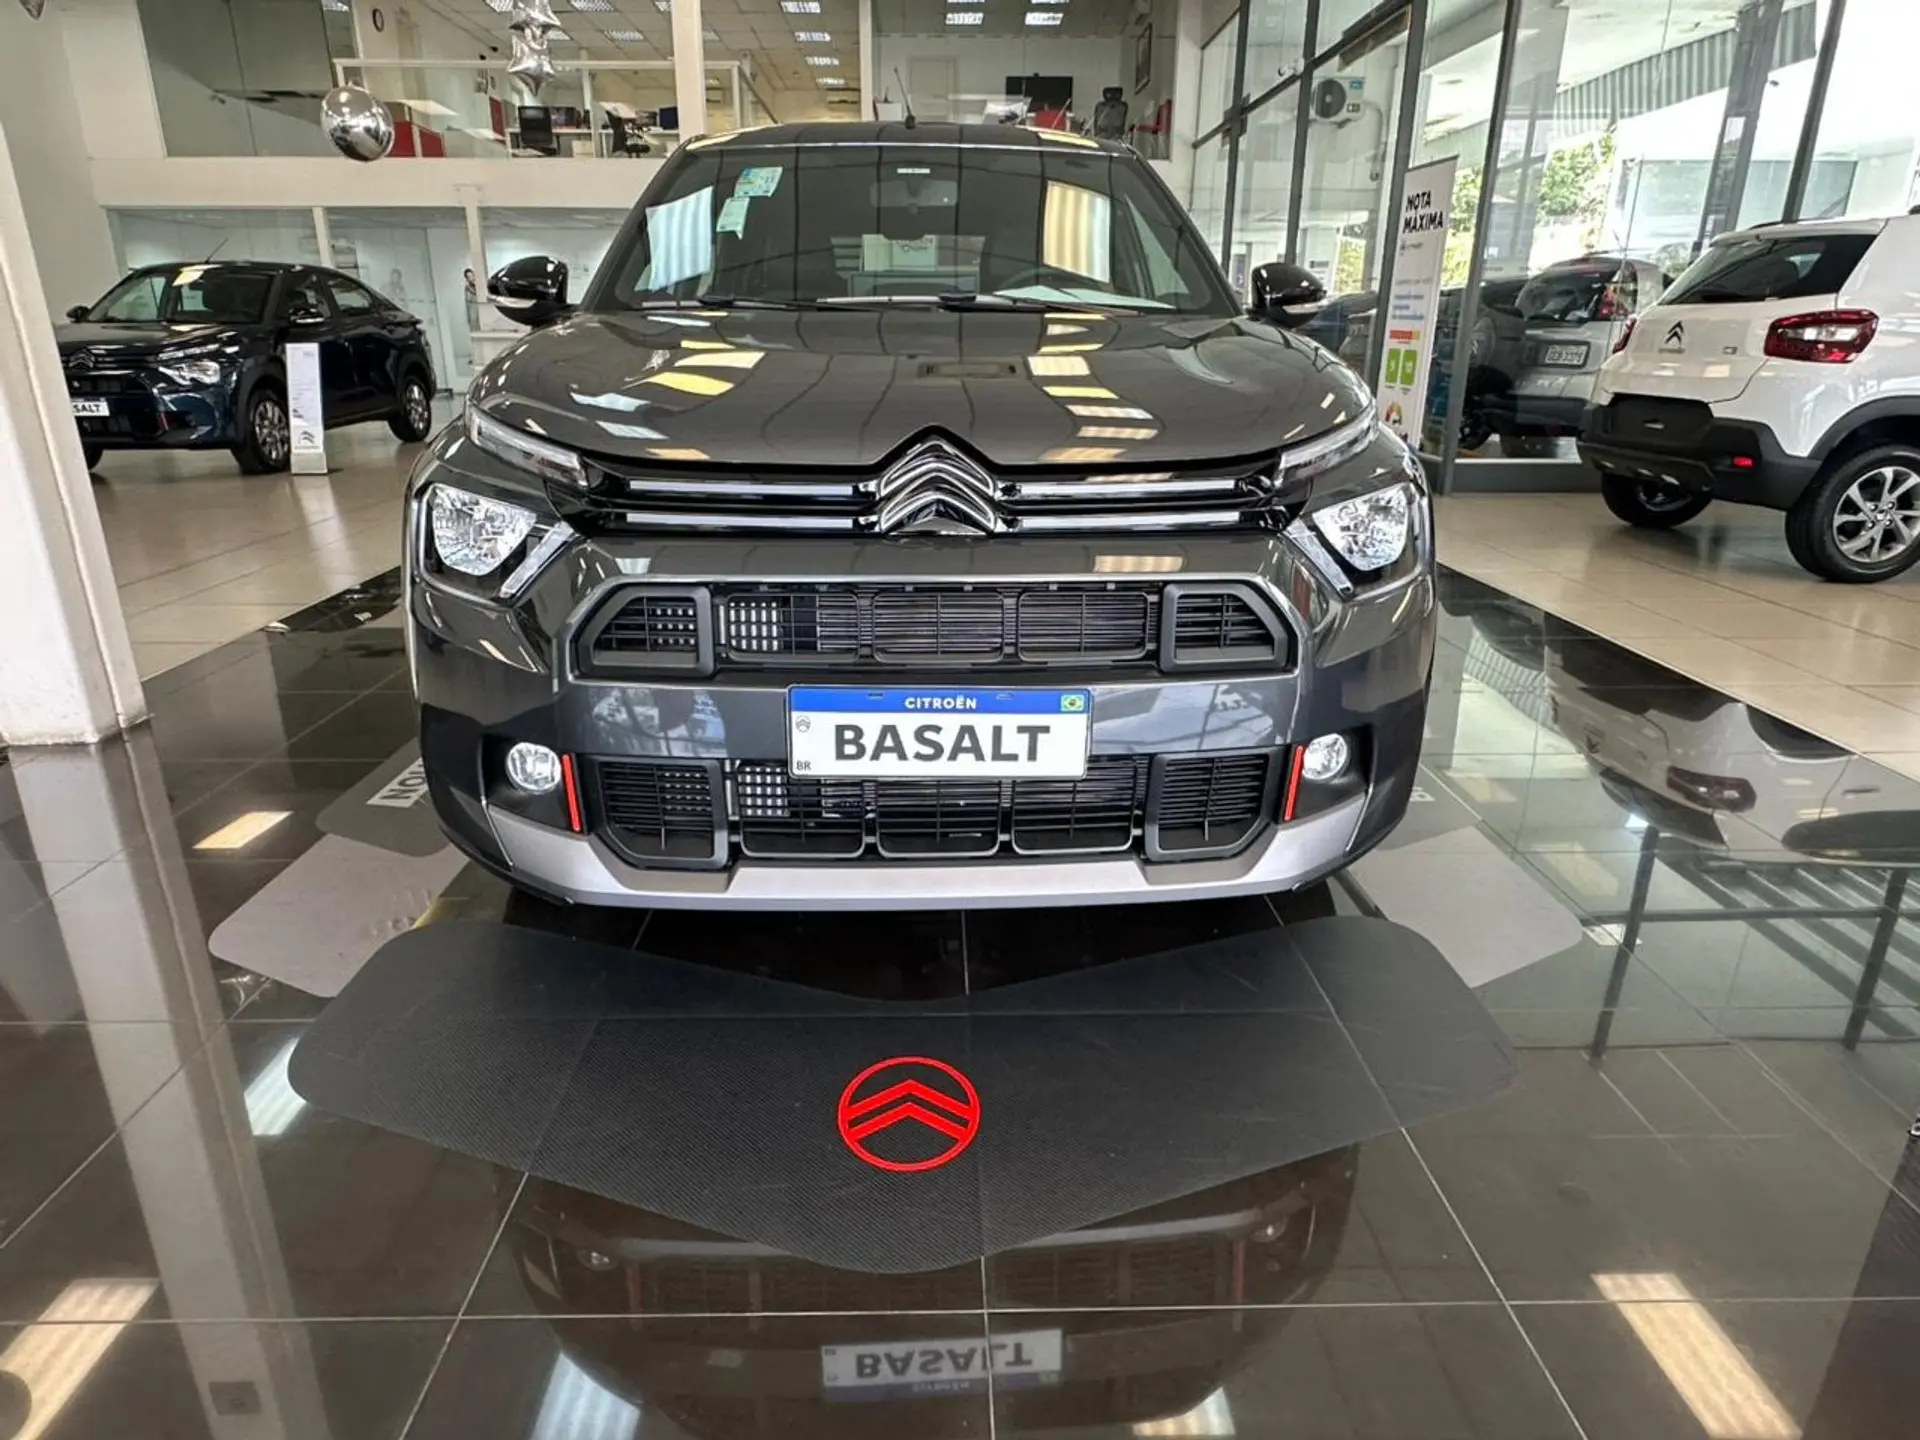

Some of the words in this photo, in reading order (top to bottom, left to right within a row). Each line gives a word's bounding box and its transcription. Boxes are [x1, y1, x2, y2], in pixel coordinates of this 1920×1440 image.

[1406, 190, 1431, 212] NOTA
[904, 695, 977, 709] CITROËN
[834, 724, 1051, 762] BASALT
[796, 761, 811, 771] BR
